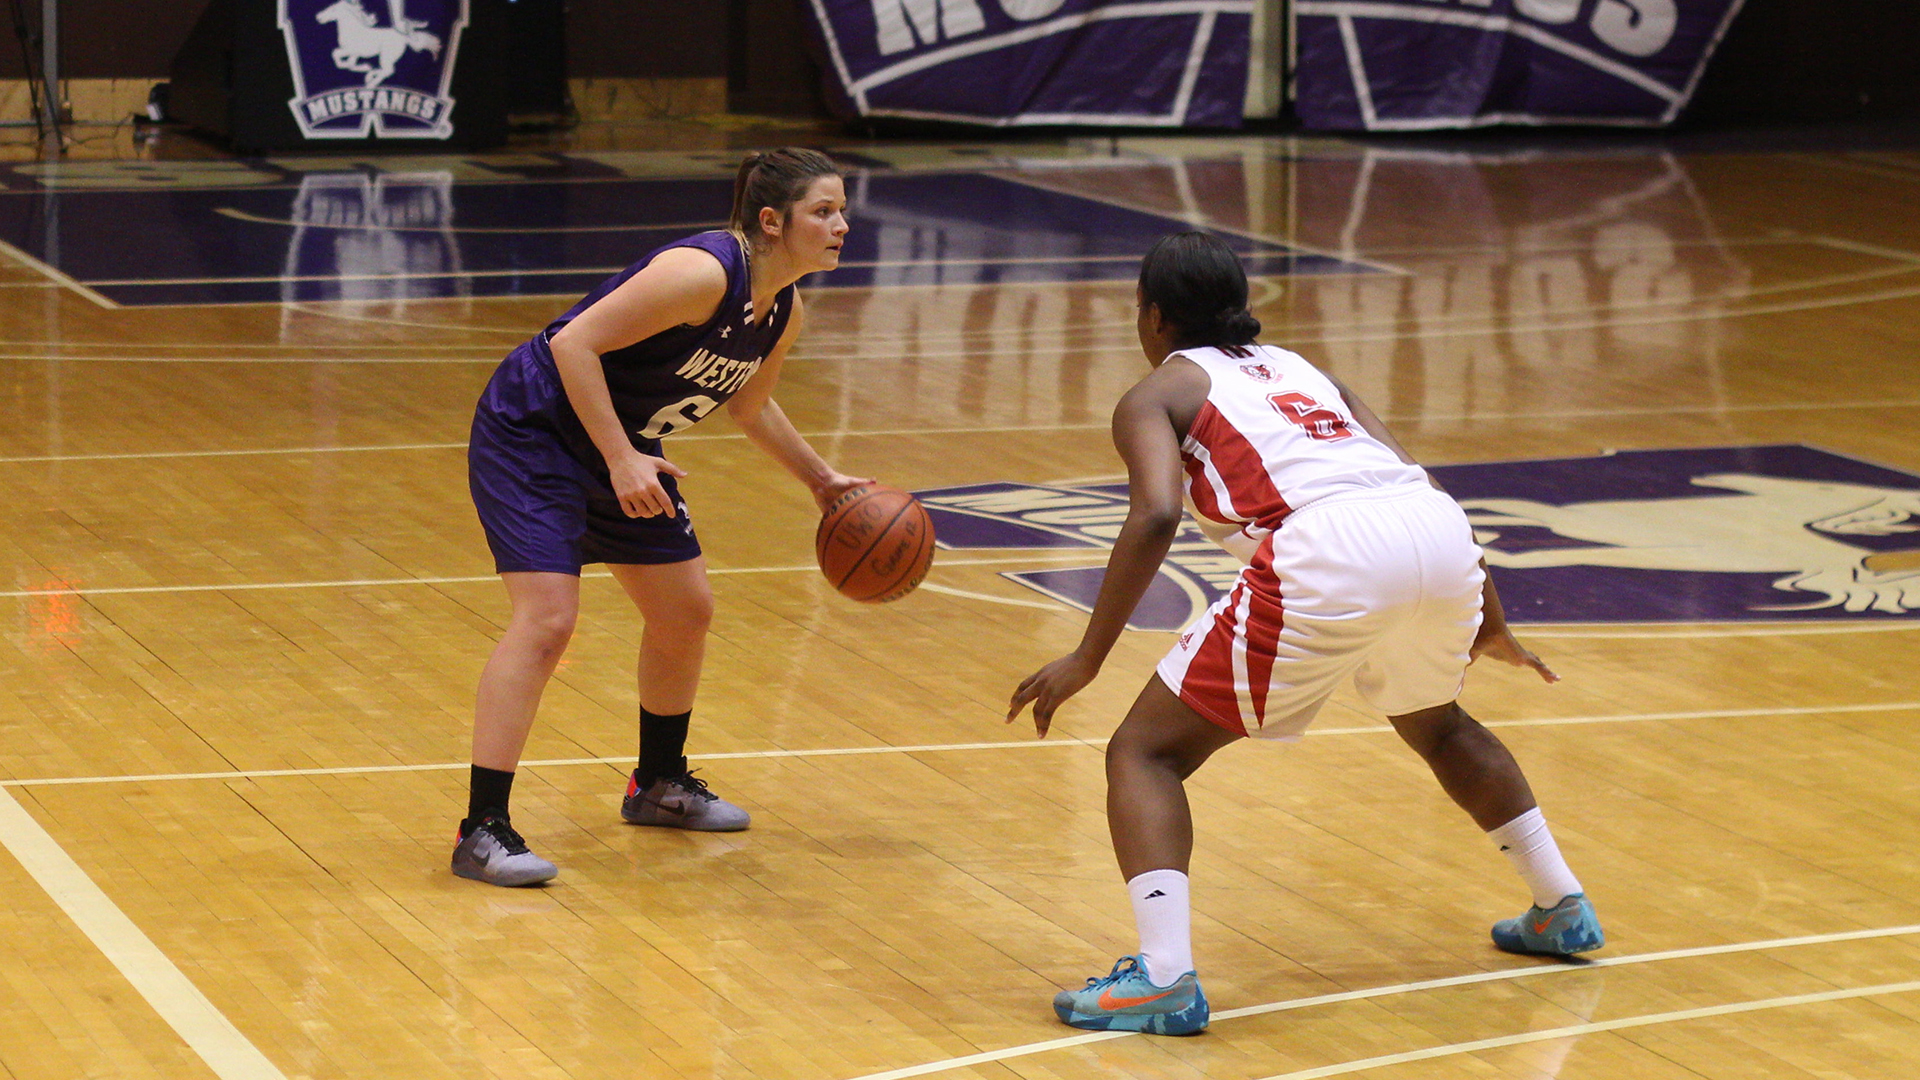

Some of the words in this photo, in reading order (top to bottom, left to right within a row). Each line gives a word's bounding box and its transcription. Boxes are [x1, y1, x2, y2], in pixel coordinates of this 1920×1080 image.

[307, 89, 437, 120] MUSTANGS
[675, 348, 763, 394] WESTE
[636, 394, 719, 440] 6
[1266, 390, 1357, 443] 6
